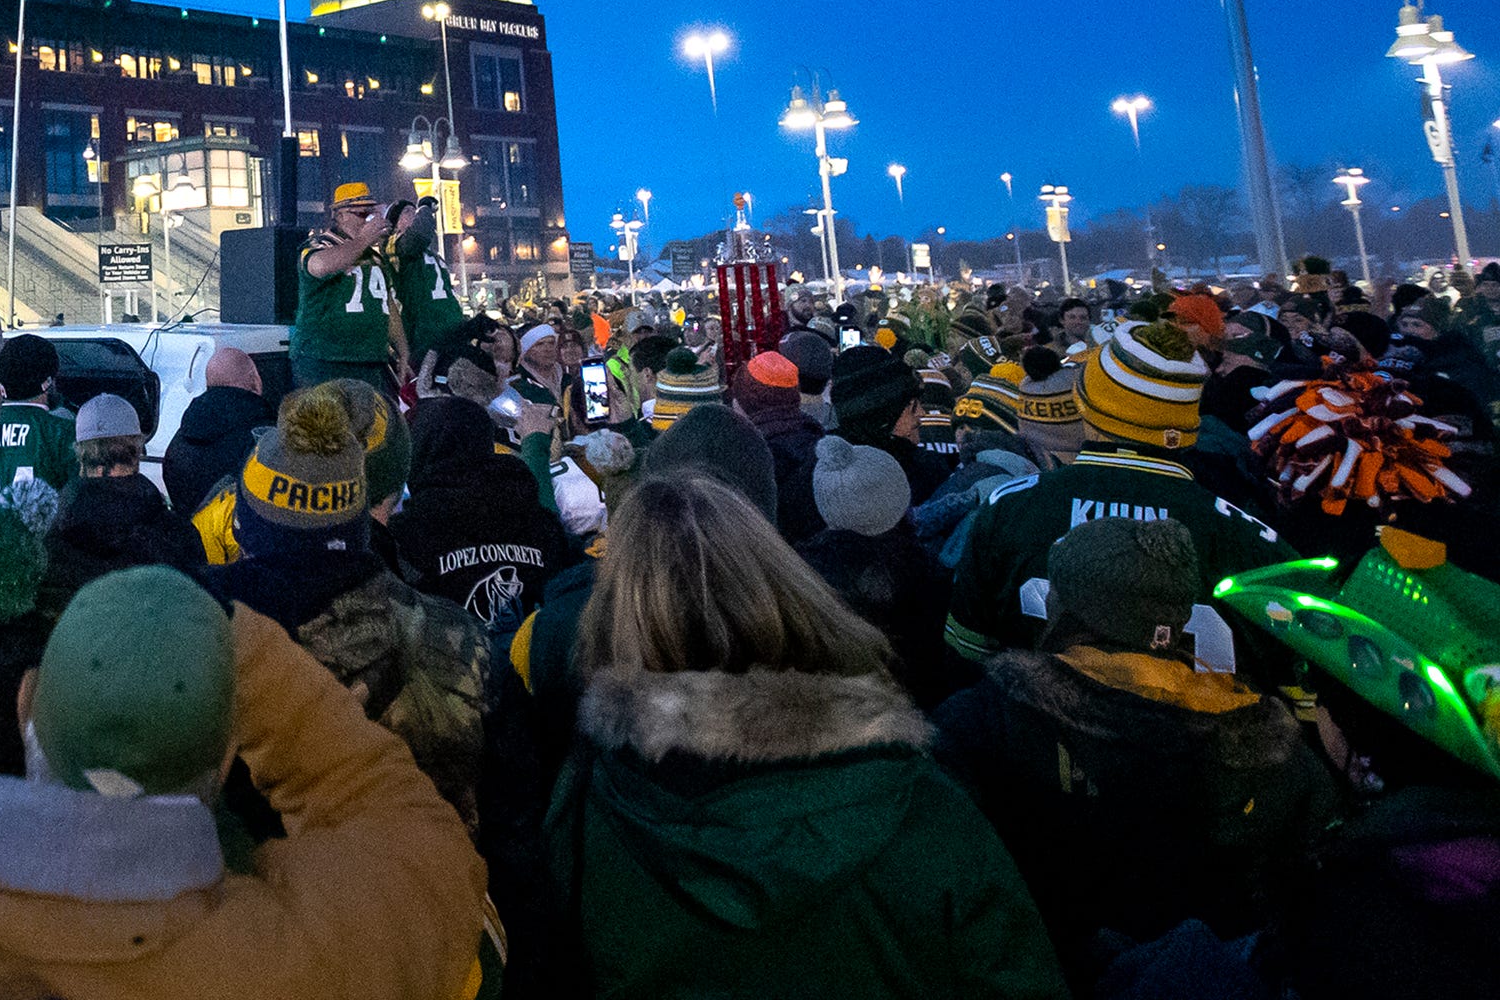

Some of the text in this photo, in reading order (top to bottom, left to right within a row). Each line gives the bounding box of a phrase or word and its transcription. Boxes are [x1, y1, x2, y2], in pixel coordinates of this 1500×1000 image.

[101, 247, 112, 255] No
[110, 255, 141, 264] Allowed
[439, 543, 544, 576] LOPEZ CONCRETE
